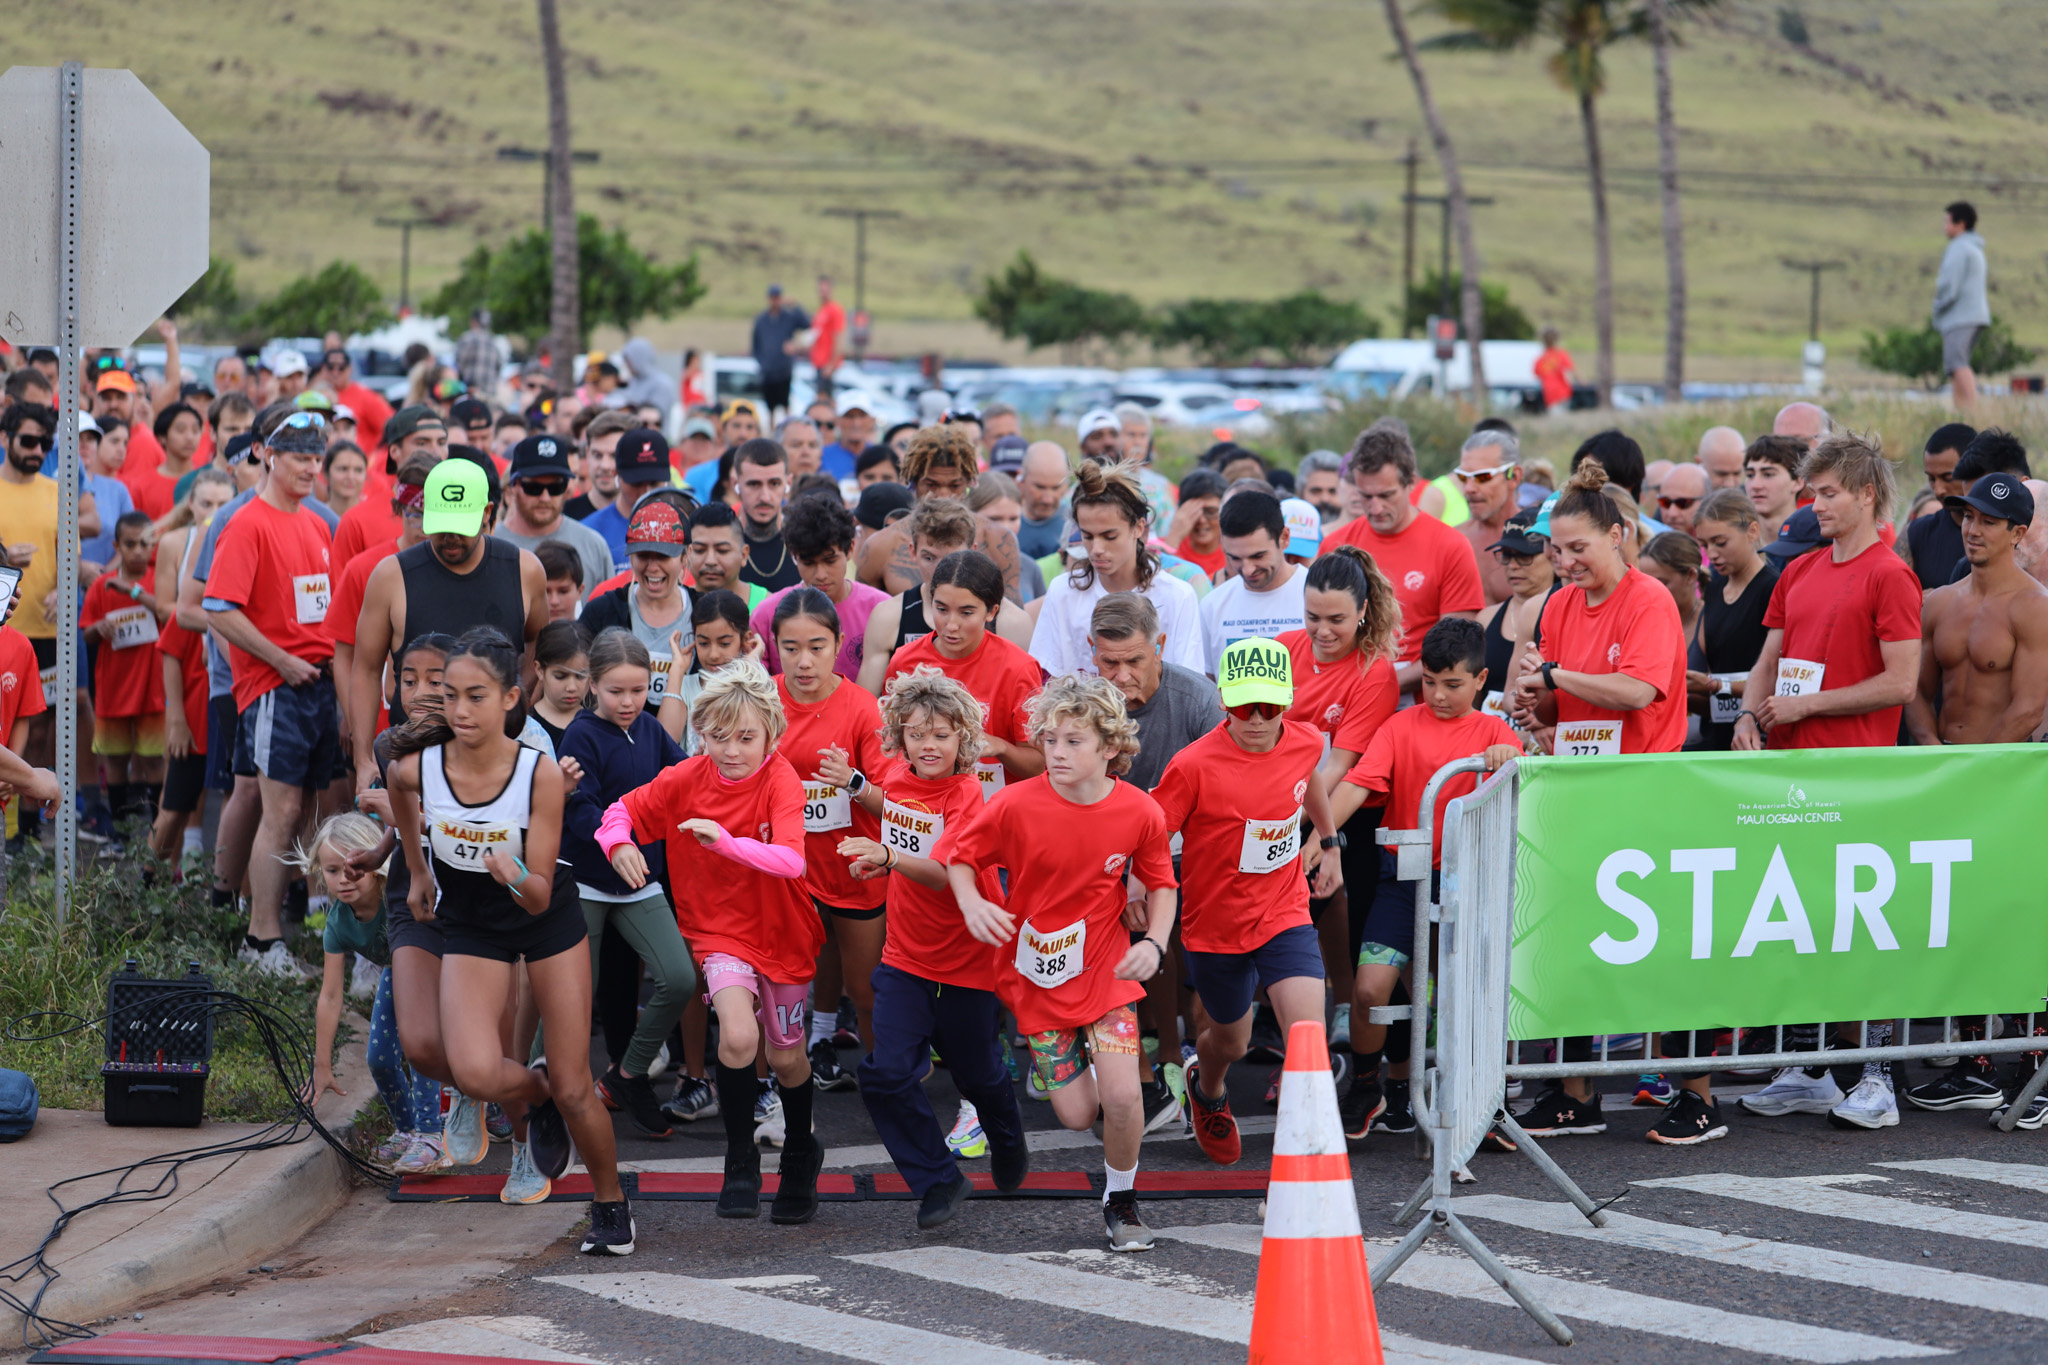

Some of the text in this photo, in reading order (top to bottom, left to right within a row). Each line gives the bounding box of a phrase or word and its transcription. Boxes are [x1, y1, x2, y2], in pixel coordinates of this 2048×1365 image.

[1227, 647, 1287, 671] MAUI
[1227, 665, 1287, 682] STRONG
[1565, 728, 1614, 742] MAUI 5K
[978, 771, 995, 782] 5K
[820, 786, 838, 799] 5K
[883, 807, 914, 830] MAUI
[914, 820, 934, 835] 5K
[1737, 812, 1843, 825] MAUI OCEAN CENTER
[444, 824, 485, 843] MAUI
[487, 829, 509, 842] 5K
[890, 827, 920, 853] 558
[1259, 821, 1294, 841] MAUI
[1267, 836, 1293, 861] 893
[1589, 839, 1972, 965] START
[1028, 931, 1079, 955] MAUI 5K
[1035, 954, 1066, 976] 388
[776, 998, 805, 1036] 14
